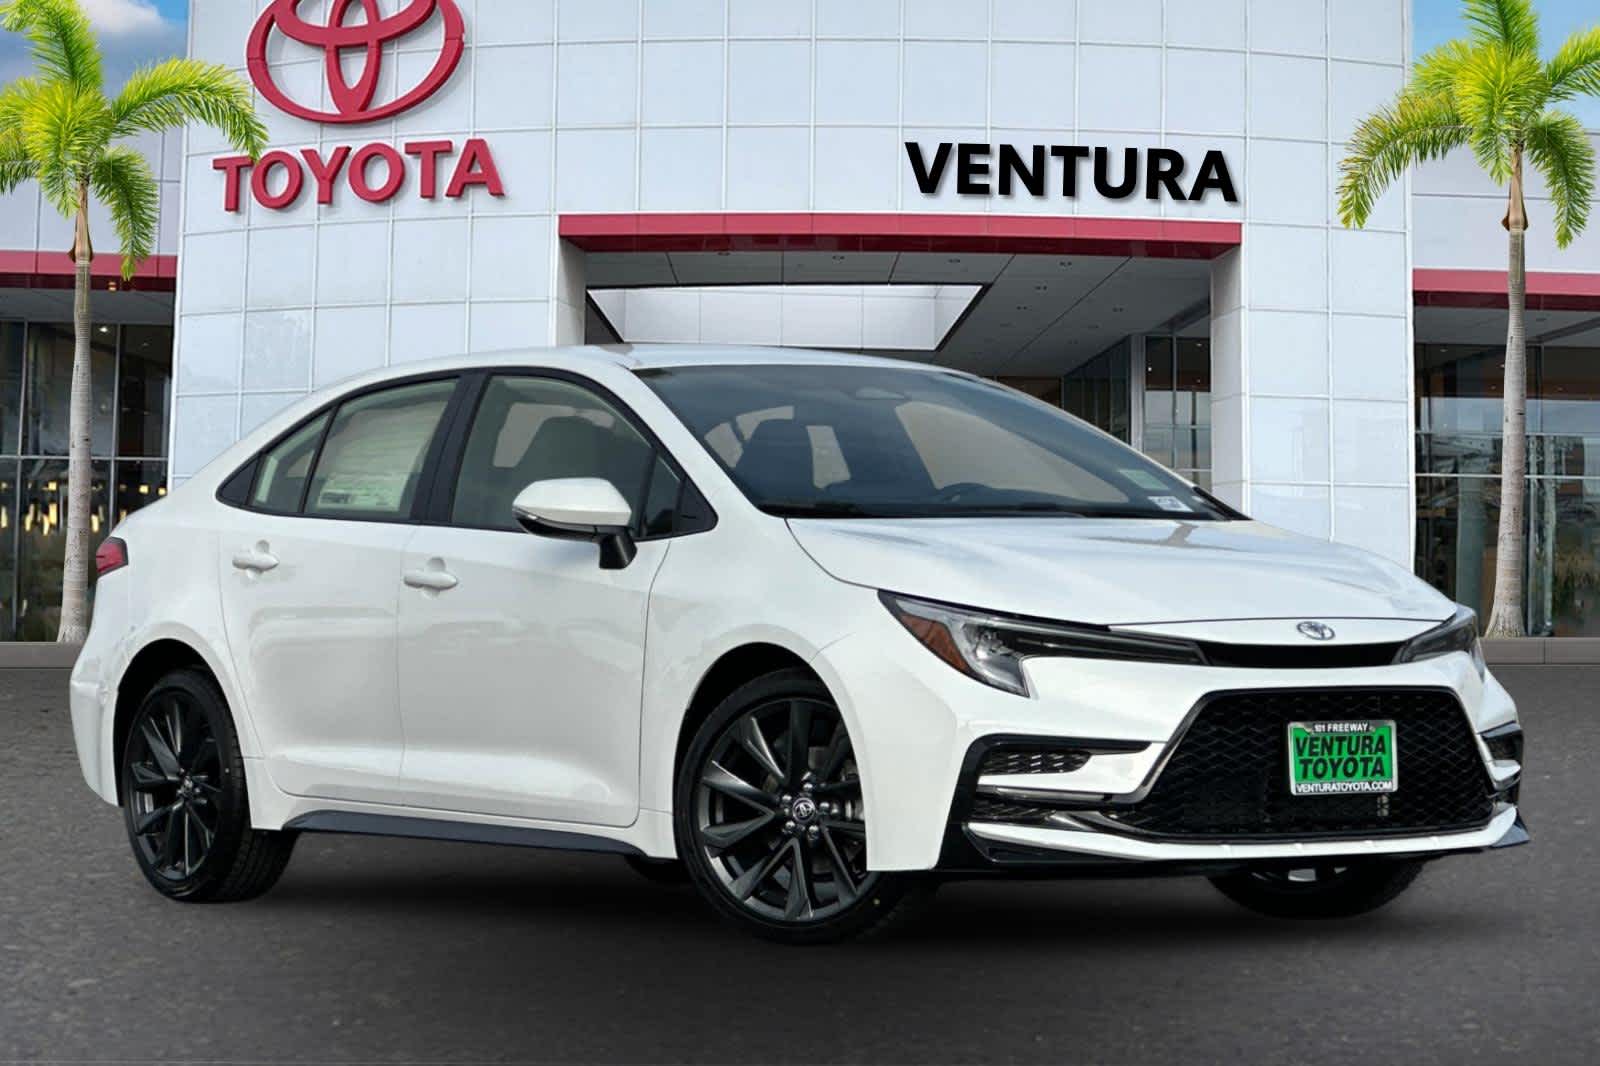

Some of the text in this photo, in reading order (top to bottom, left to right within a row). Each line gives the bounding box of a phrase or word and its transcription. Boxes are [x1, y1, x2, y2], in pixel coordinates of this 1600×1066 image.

[213, 138, 505, 212] TOYOTA
[904, 141, 1239, 203] VENTURA
[1327, 723, 1369, 732] FREEWAY
[1295, 735, 1386, 757] VENTURA
[1298, 756, 1386, 779] TOYOTA
[1296, 780, 1393, 793] VENTURATOYOTA.COM
